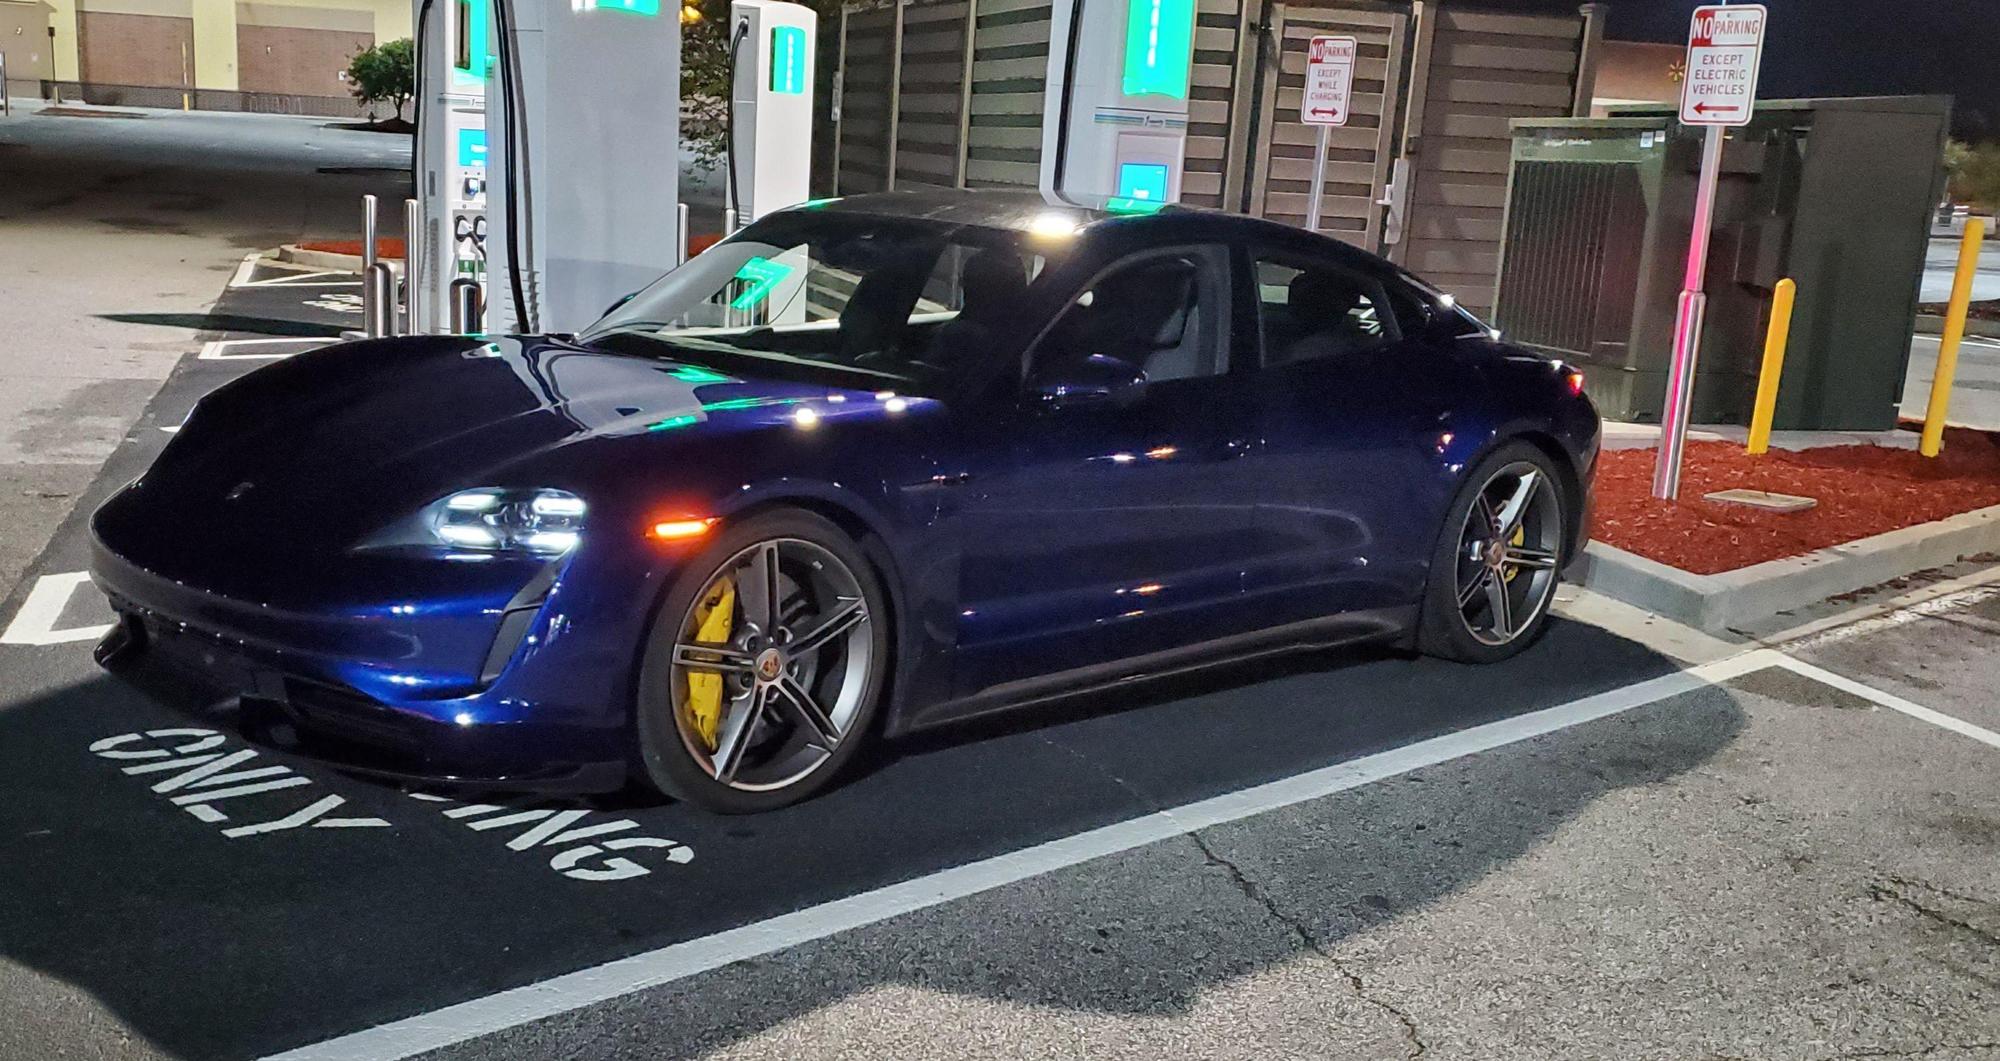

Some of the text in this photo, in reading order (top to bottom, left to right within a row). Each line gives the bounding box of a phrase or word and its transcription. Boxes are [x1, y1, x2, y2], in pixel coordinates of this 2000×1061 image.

[1693, 17, 1759, 39] NO PARKING
[1311, 42, 1352, 60] NO PARKING
[1702, 54, 1744, 65] EXCEPT
[1317, 69, 1342, 78] EXCEPT
[1694, 69, 1746, 80] ELECTRIC
[1318, 81, 1337, 90] WHILE
[1693, 84, 1745, 95] VEHICLES
[1310, 92, 1342, 102] CHARGING
[89, 728, 392, 838] ONLY
